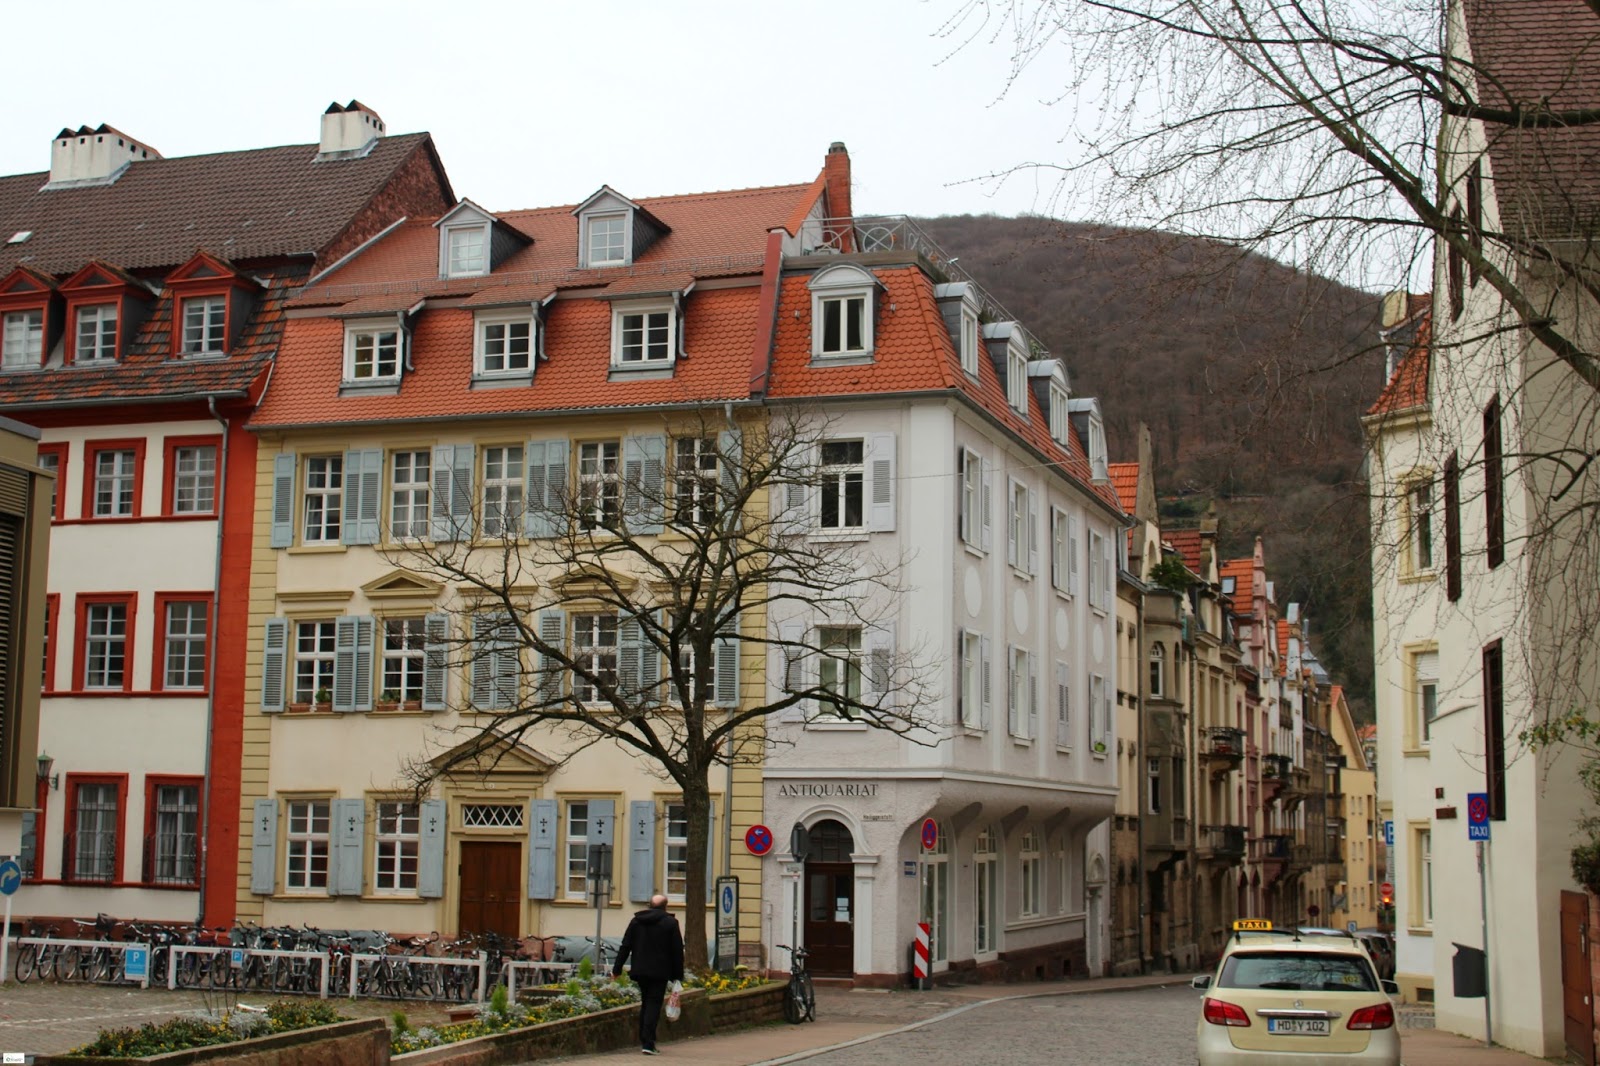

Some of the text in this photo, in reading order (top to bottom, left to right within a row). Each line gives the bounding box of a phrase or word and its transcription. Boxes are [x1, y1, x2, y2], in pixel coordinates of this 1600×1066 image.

[779, 784, 878, 798] ANTIQUARIAT
[1470, 826, 1488, 836] TAXI
[133, 951, 140, 962] P
